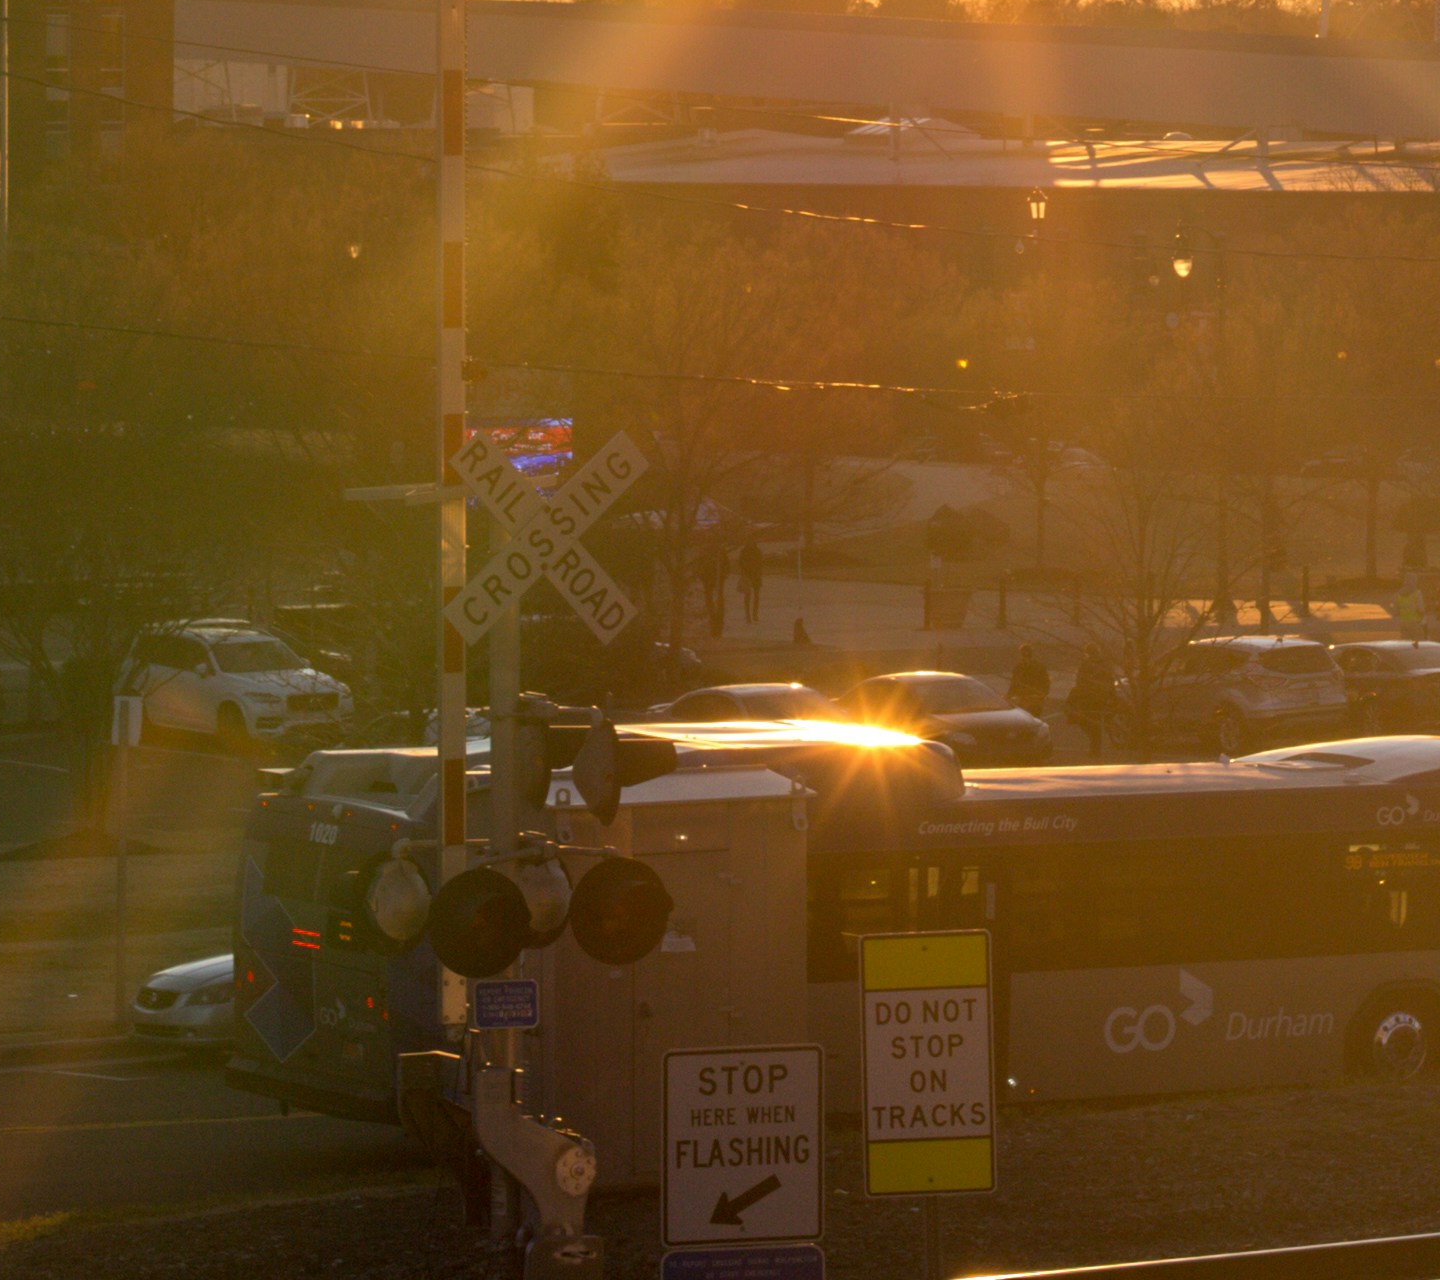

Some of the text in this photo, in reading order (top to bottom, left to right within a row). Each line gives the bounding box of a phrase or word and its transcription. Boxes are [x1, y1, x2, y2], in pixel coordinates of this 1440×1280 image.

[462, 452, 632, 625] CROSSING
[918, 814, 1079, 836] Connecting the Bull City
[1376, 806, 1405, 826] GO
[309, 821, 339, 846] 1020
[875, 998, 977, 1025] DO NOT
[1104, 1004, 1334, 1054] GO Durham
[891, 1034, 964, 1060] STOP
[698, 1064, 789, 1096] STOP
[910, 1069, 947, 1093] ON
[691, 1105, 796, 1127] HERE WHEN
[872, 1102, 986, 1130] TRACKS
[675, 1134, 810, 1169] FLASHING
